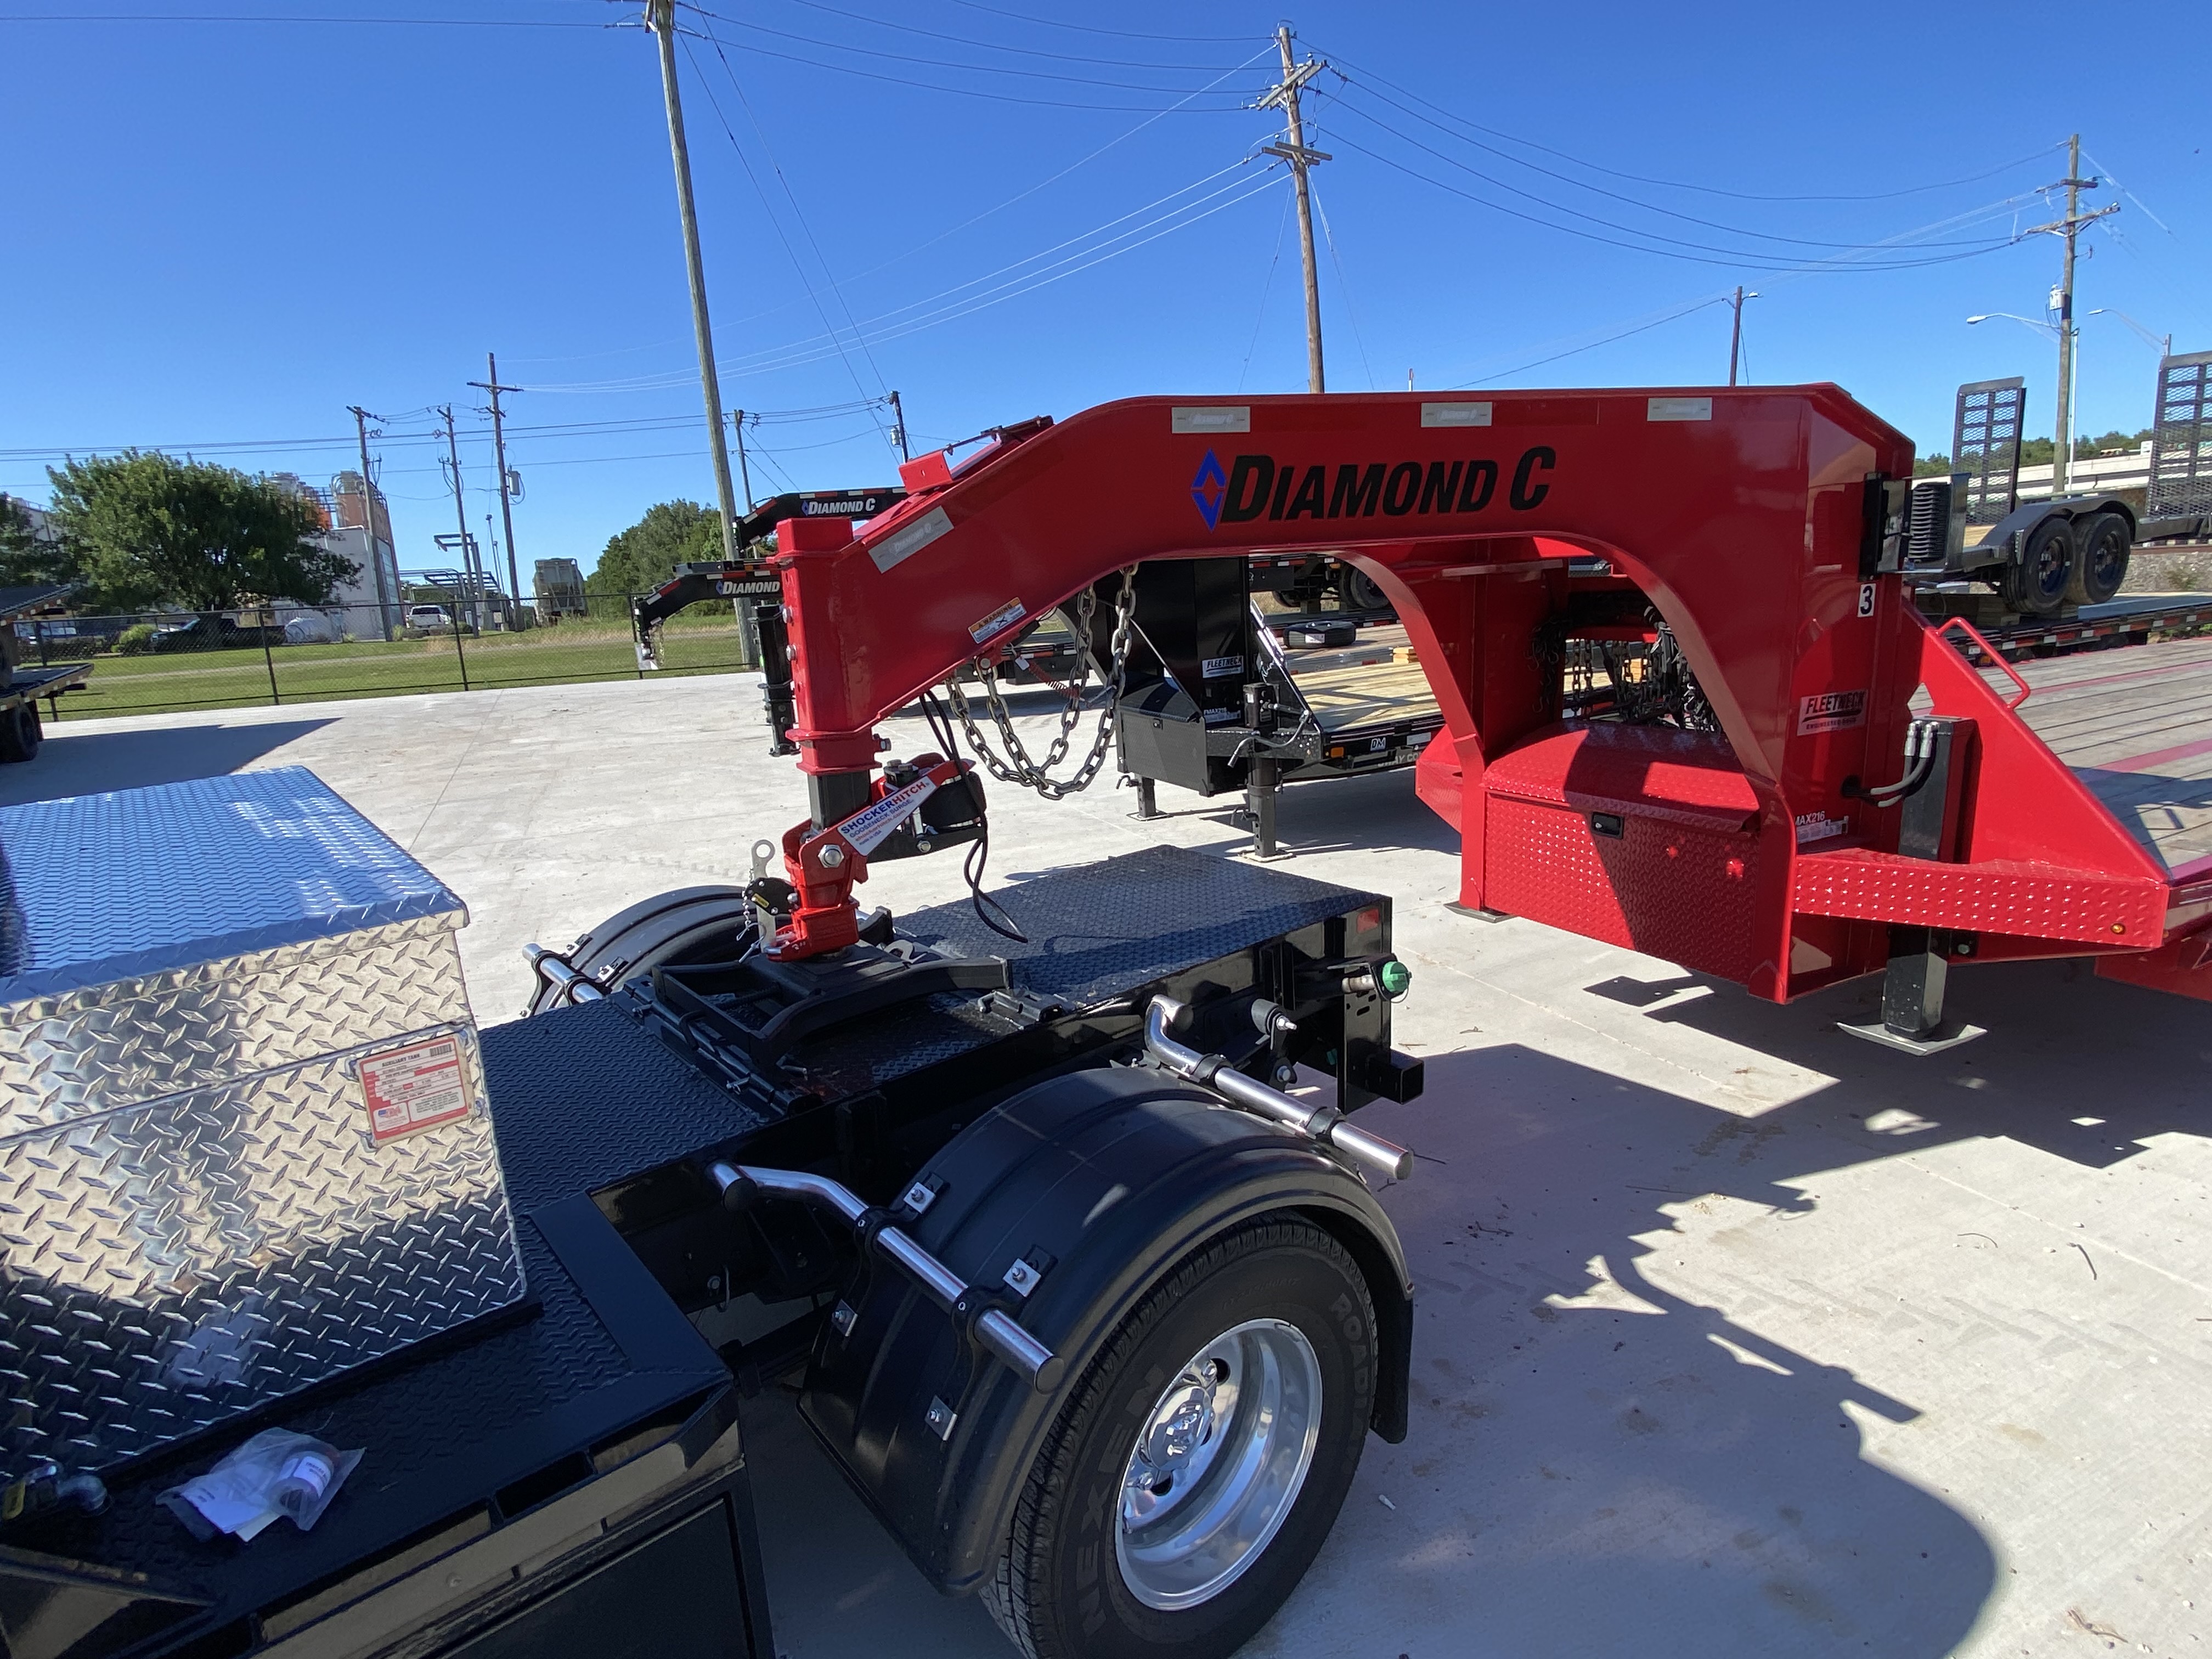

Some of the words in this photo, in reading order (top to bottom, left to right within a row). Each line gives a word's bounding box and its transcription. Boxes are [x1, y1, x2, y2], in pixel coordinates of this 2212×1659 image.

[1221, 454, 1498, 523] DIAMOND
[1510, 445, 1556, 511] C
[808, 500, 864, 515] DIAMOND
[865, 498, 876, 511] C
[723, 581, 780, 595] DIAMOND
[1860, 585, 1872, 614] 3
[983, 603, 1012, 623] WARNING
[1805, 691, 1865, 714] FLEETNECK
[841, 781, 927, 834] SHOCKERHITCH
[850, 812, 890, 838] GOOSENECK
